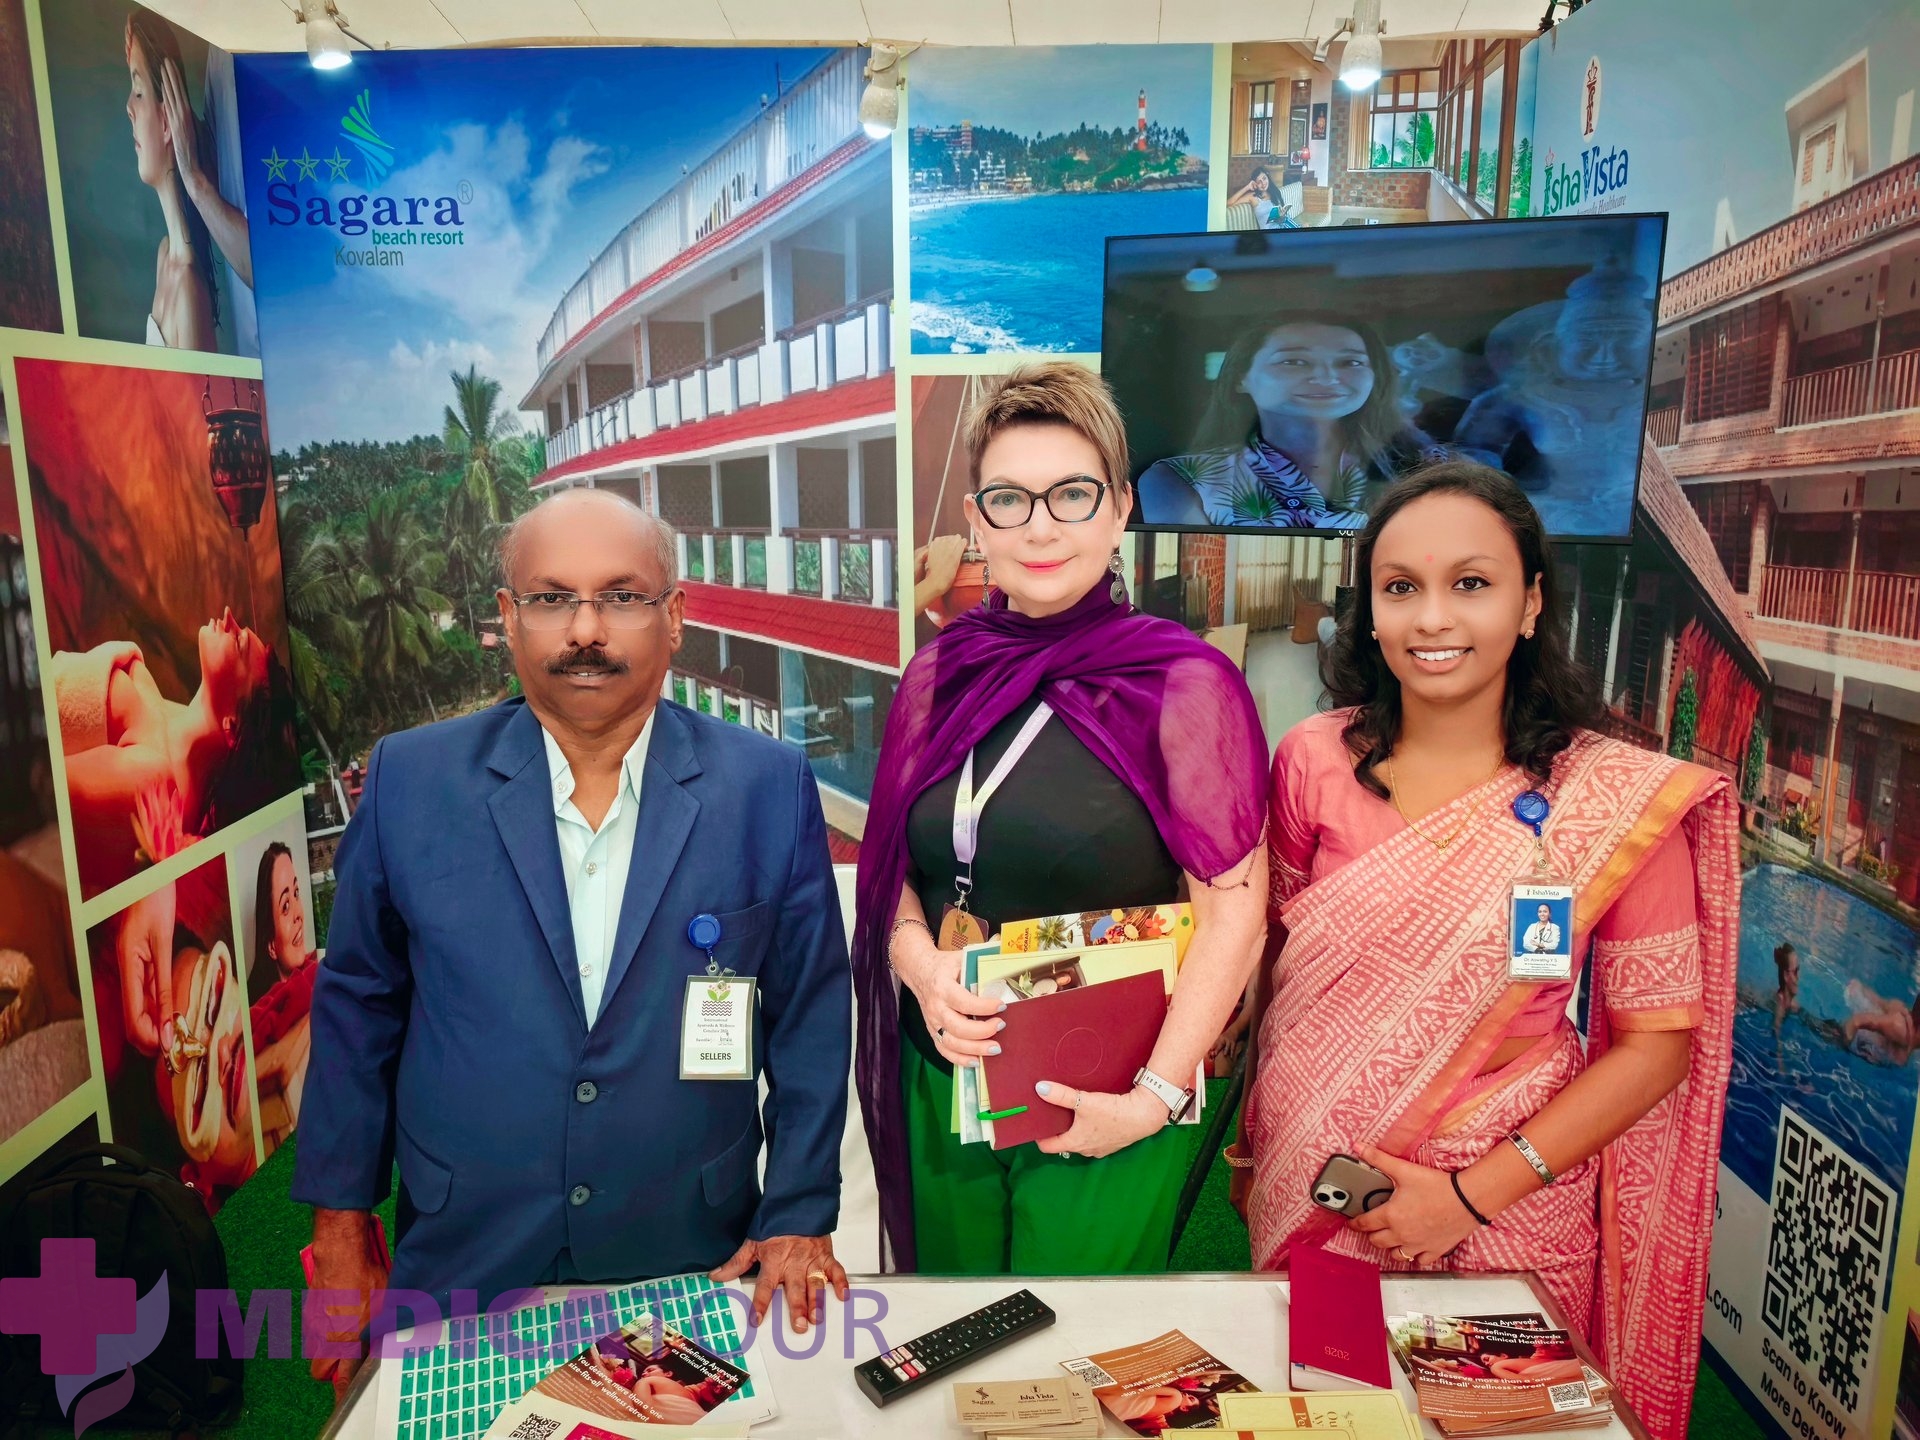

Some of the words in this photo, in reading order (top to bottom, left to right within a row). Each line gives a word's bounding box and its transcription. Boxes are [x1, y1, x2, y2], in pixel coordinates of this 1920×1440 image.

[267, 183, 464, 236] Sagara
[372, 229, 417, 246] beach
[421, 229, 464, 246] resort
[335, 245, 404, 266] Kovalam
[700, 1052, 732, 1061] SELLERS
[1473, 1326, 1518, 1339] Redefining
[1486, 1335, 1517, 1344] Clinical
[671, 1348, 680, 1356] as
[679, 1352, 701, 1371] Clinical
[699, 1366, 733, 1390] Healthcare
[678, 1342, 709, 1367] Redefining
[708, 1362, 739, 1383] Ayurveda
[1204, 1362, 1221, 1372] You
[1147, 1369, 1175, 1384] wellness
[1161, 1374, 1181, 1383] more
[1180, 1366, 1205, 1379] deserve
[1417, 1367, 1436, 1377] You
[1438, 1371, 1473, 1382] deserve
[1501, 1376, 1523, 1384] than
[577, 1355, 590, 1368] You
[588, 1363, 613, 1384] deserve
[612, 1382, 630, 1397] more
[628, 1391, 644, 1407] than
[1122, 1379, 1148, 1390] retreat
[1144, 1379, 1162, 1391] than
[1472, 1382, 1511, 1391] wellness
[1513, 1382, 1546, 1390] retreat
[1762, 1337, 1791, 1382] Scan
[1793, 1371, 1806, 1396] to
[1807, 1387, 1846, 1440] Know
[1760, 1371, 1791, 1417] More
[601, 1387, 628, 1408] wellness
[625, 1404, 650, 1423] retreat
